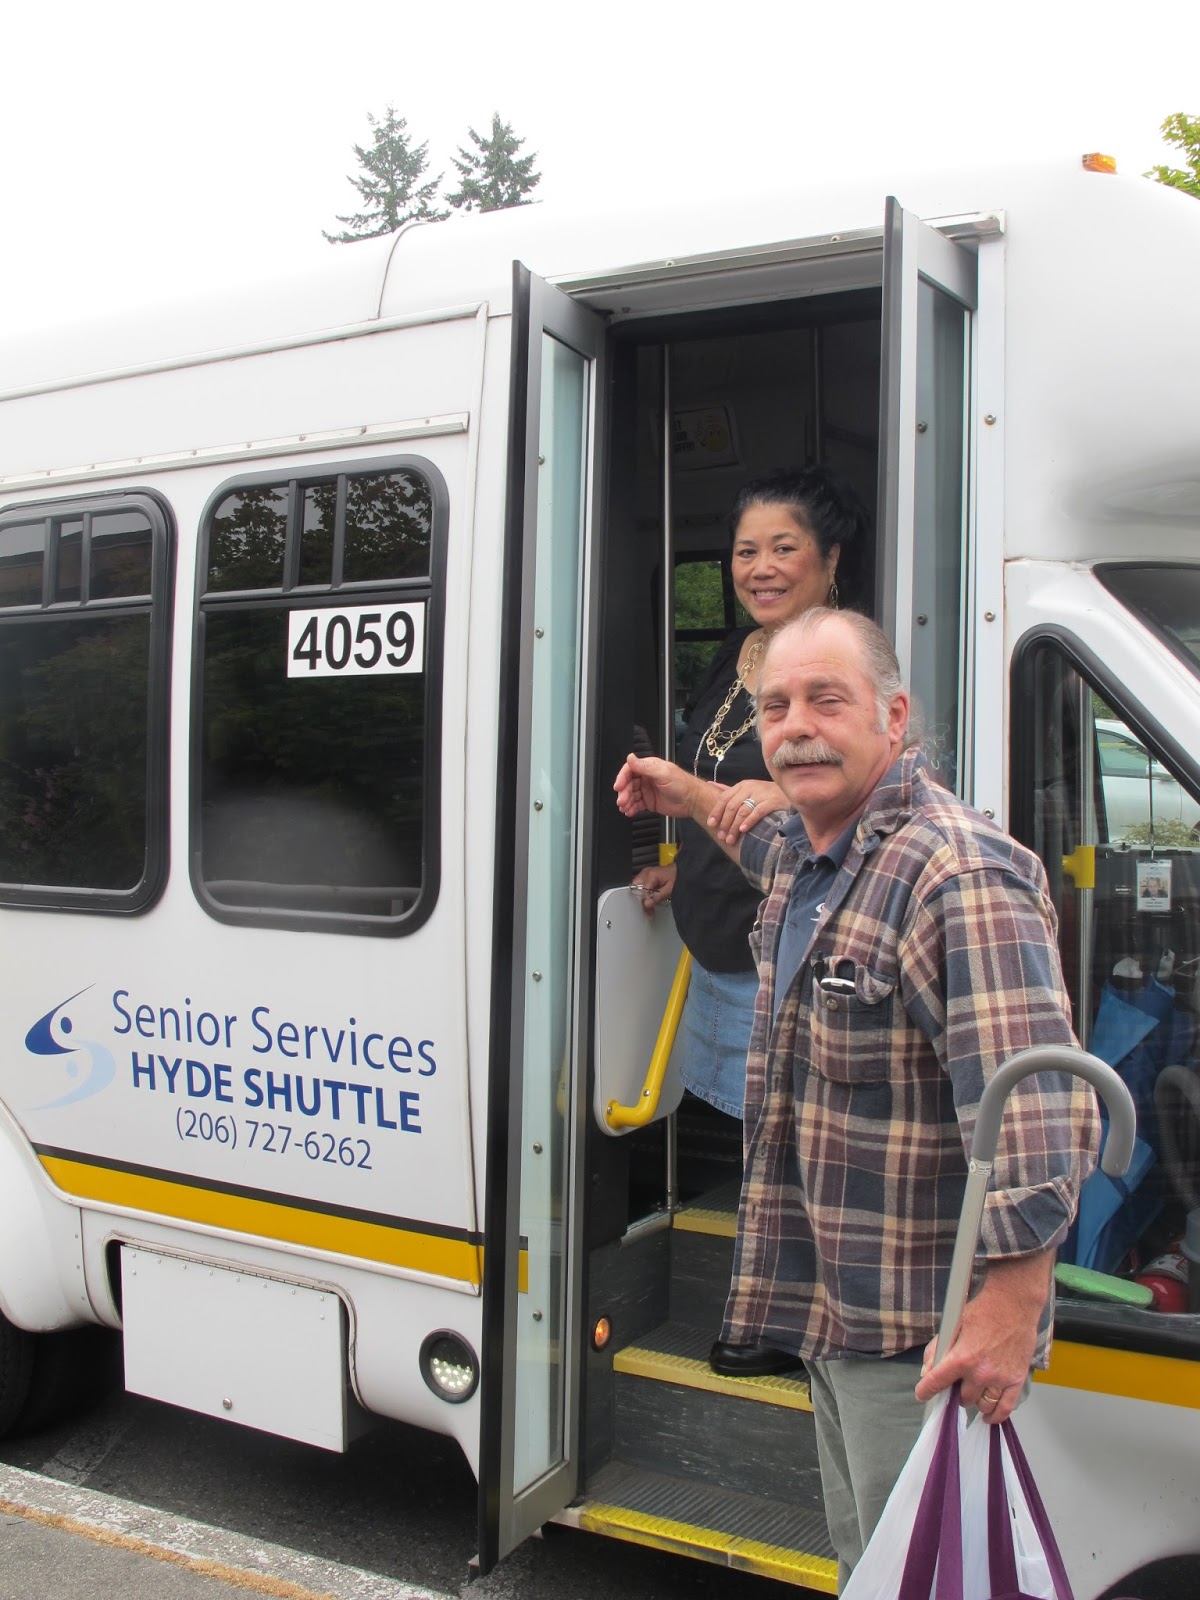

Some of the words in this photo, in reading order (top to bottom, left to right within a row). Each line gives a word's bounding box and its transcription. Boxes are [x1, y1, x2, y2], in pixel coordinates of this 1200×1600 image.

[292, 610, 415, 671] 4059
[112, 989, 238, 1049] Senior
[250, 1006, 438, 1077] Services
[131, 1051, 235, 1103] HYDE
[243, 1068, 423, 1134] SHUTTLE
[175, 1106, 238, 1150] (206)
[245, 1119, 374, 1170] 727-6262
